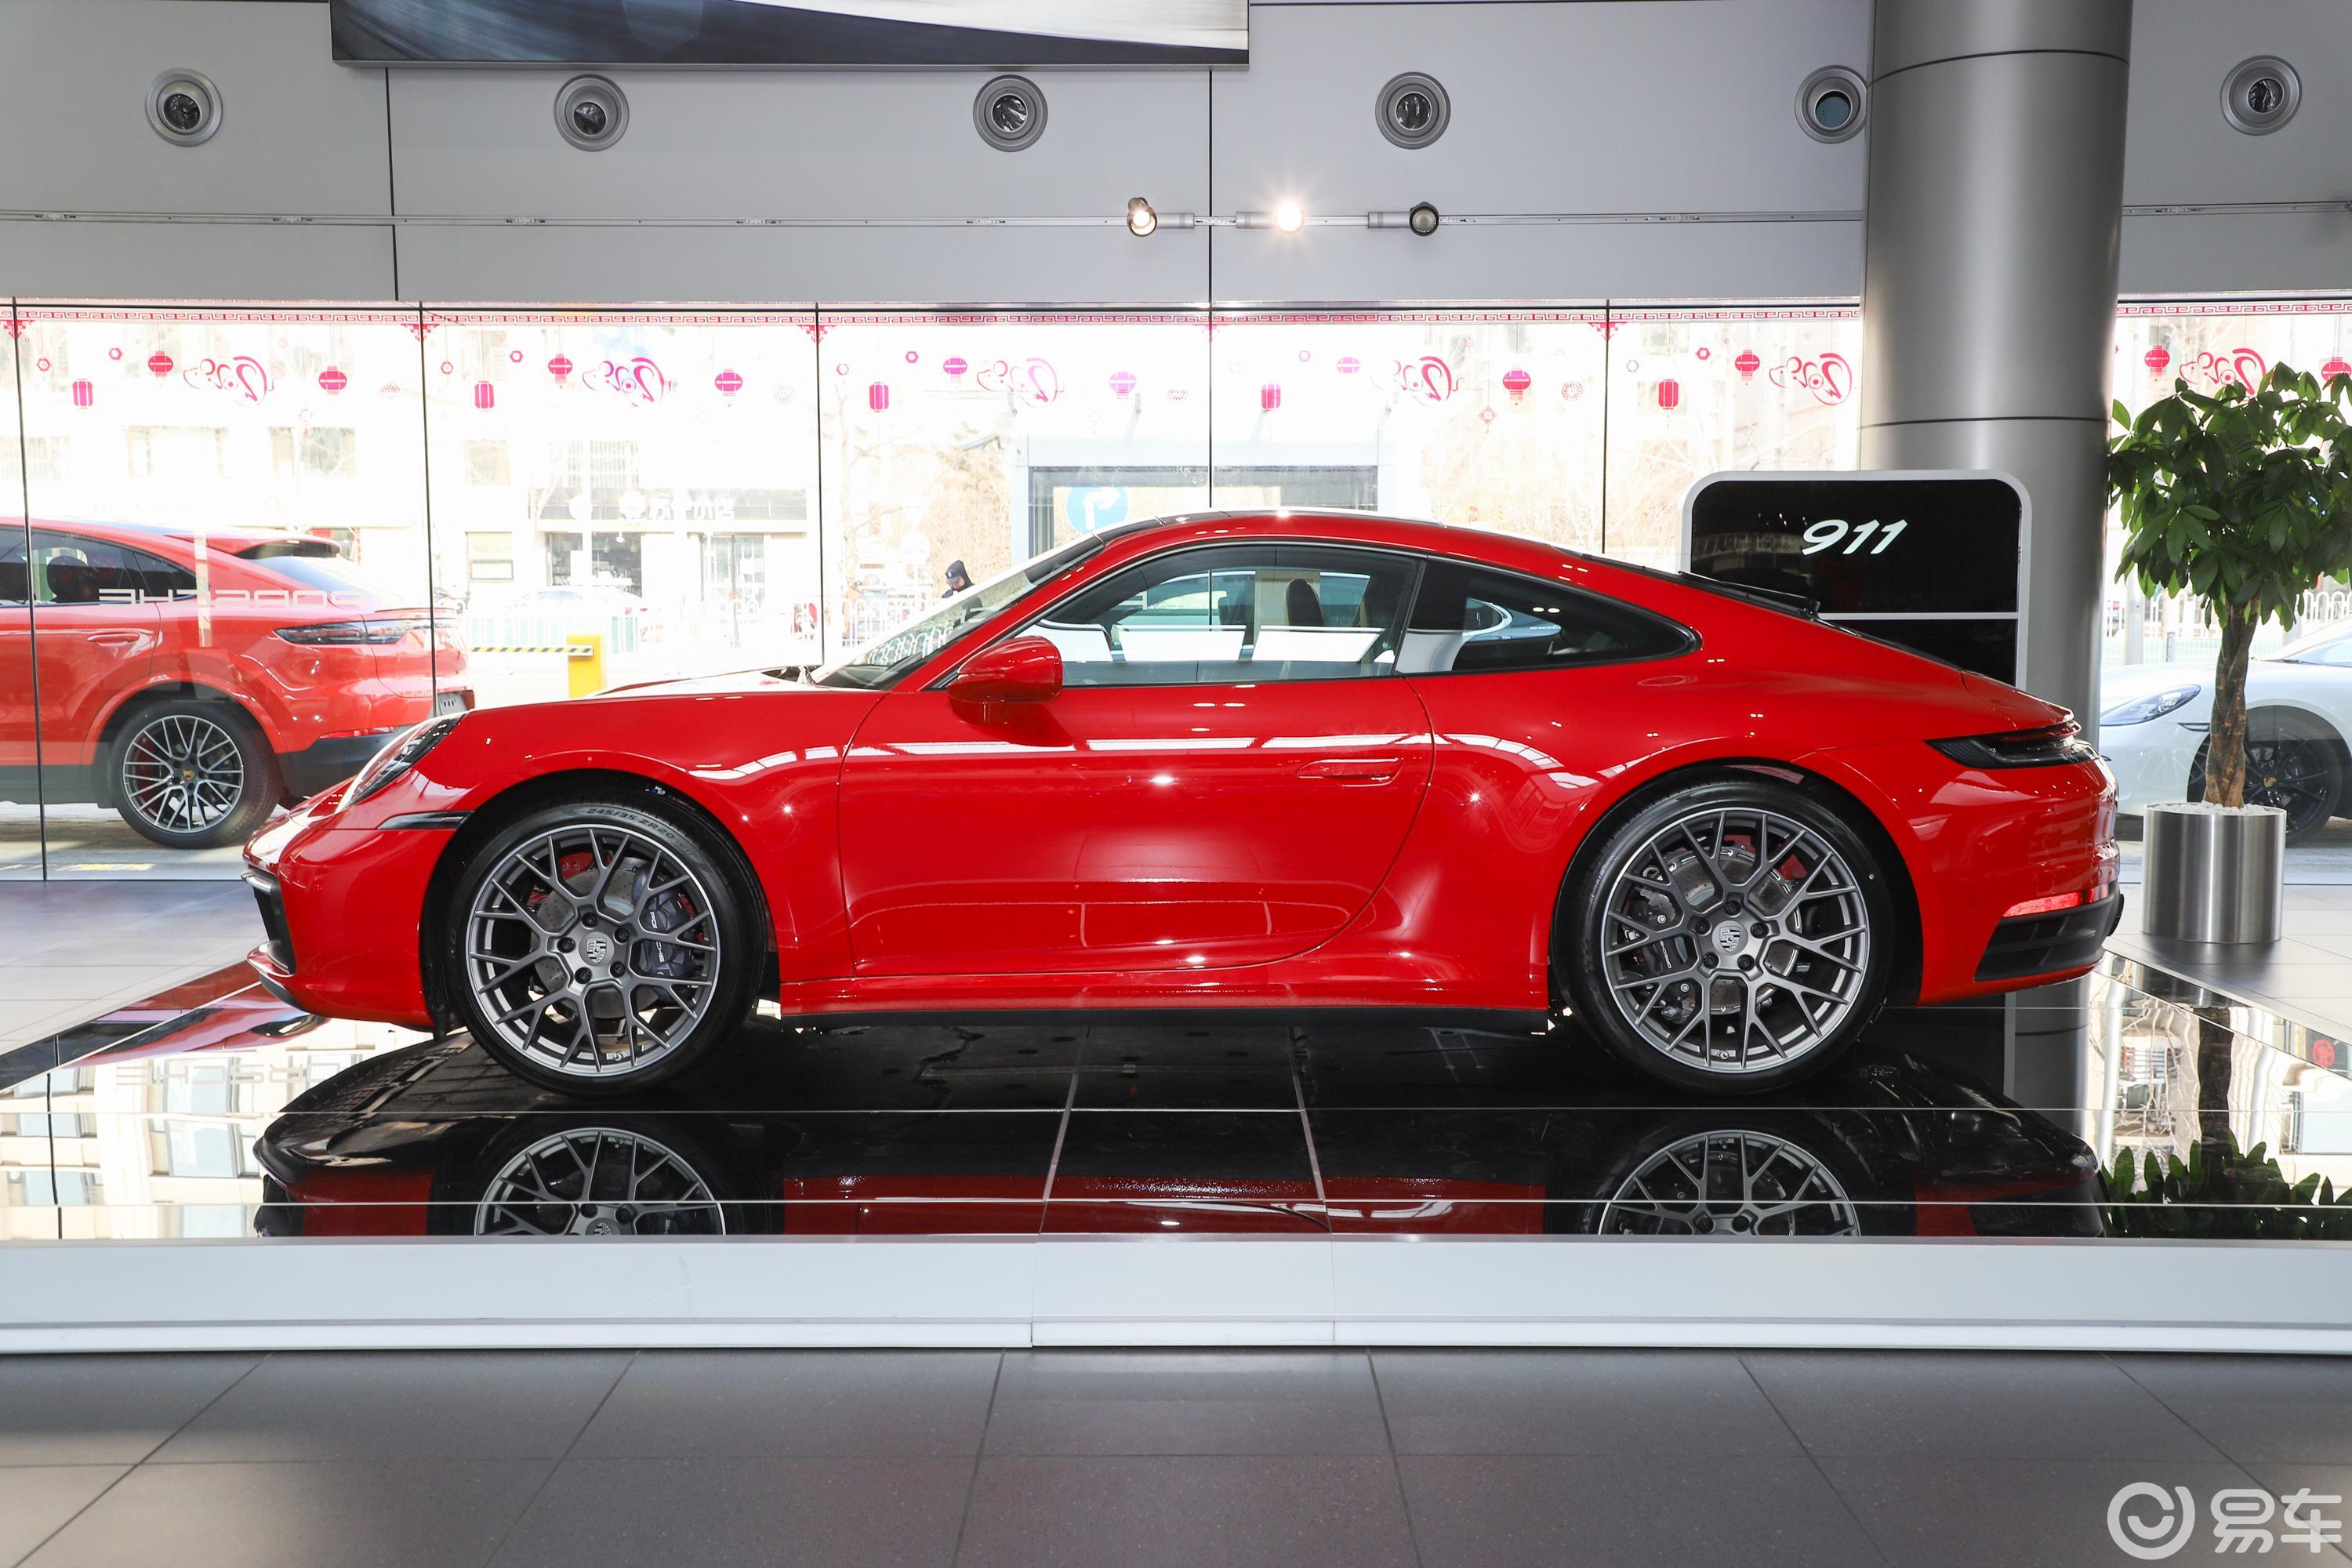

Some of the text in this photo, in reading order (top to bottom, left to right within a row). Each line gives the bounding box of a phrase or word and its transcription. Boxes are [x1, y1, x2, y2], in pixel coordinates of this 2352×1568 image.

[1802, 519, 1908, 556] 911
[588, 808, 675, 840] 245/35 ZR20
[649, 911, 665, 963] POCHE
